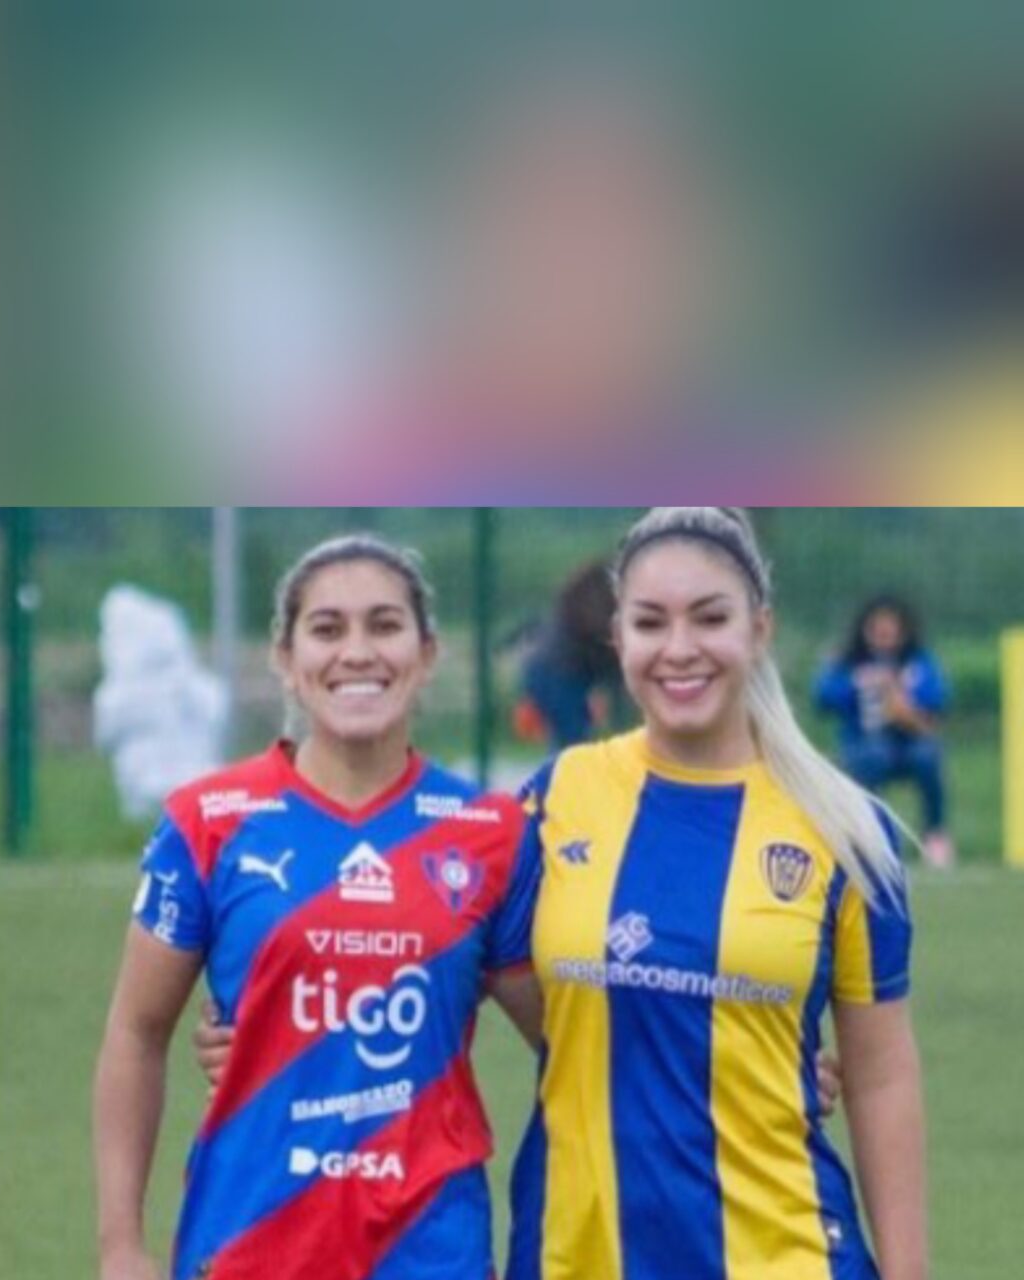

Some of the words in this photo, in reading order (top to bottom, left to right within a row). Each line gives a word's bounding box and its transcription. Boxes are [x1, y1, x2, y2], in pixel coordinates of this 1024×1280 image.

[305, 930, 423, 957] VISION
[290, 964, 431, 1042] tigo
[320, 1151, 406, 1180] GPSA
